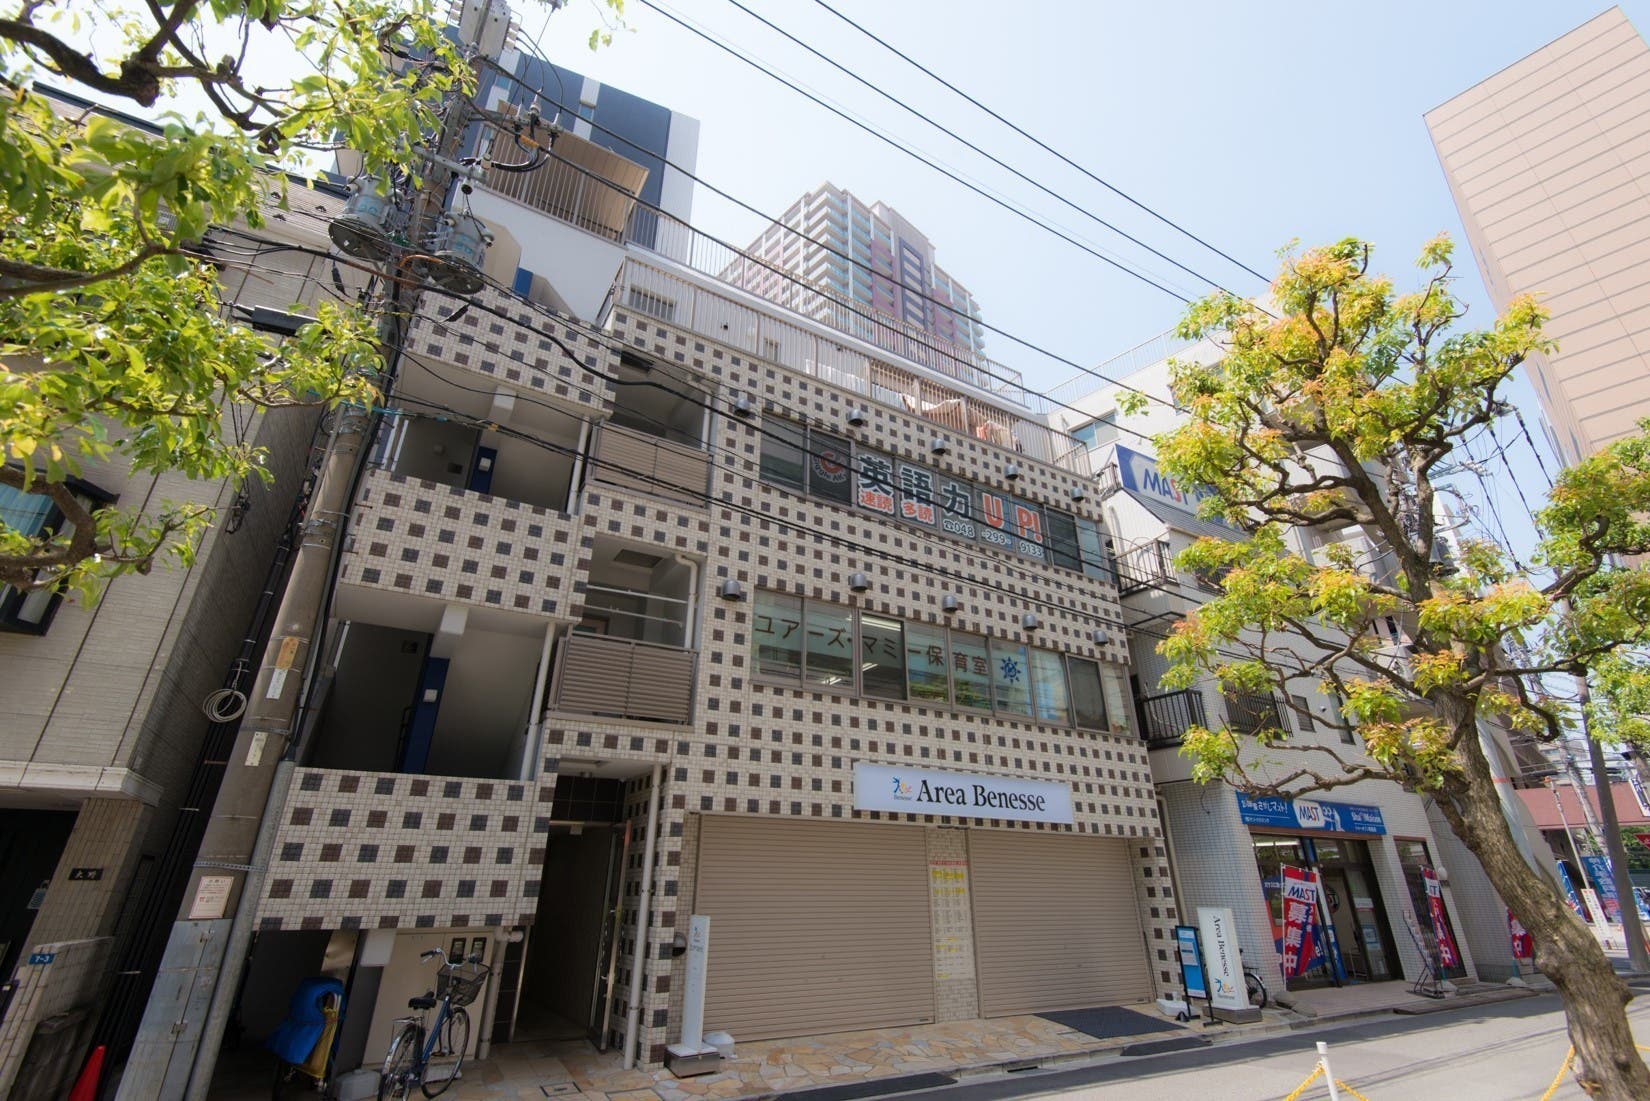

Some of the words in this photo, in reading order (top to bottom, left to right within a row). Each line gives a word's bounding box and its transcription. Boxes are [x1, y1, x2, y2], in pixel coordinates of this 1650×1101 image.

[860, 489, 893, 513] 速読
[902, 501, 934, 523] 多読
[916, 779, 966, 805] Area
[972, 784, 1046, 812] Benesse
[1299, 805, 1320, 822] MAST
[1288, 886, 1316, 902] MAST
[1213, 915, 1222, 938] Area
[1218, 940, 1230, 977] Benesse
